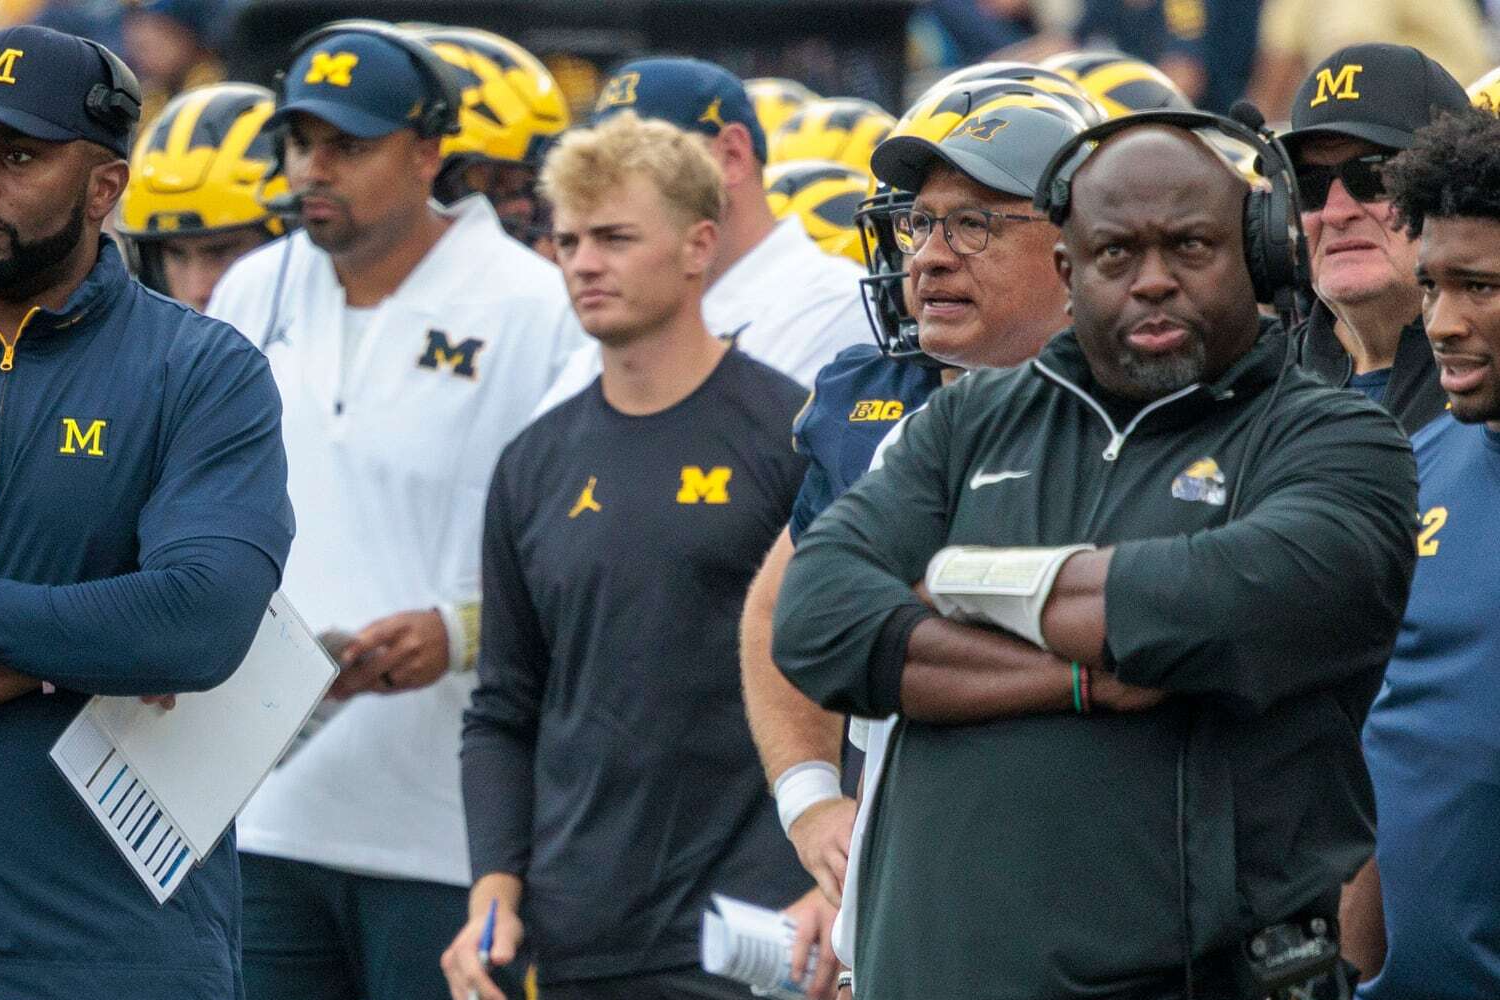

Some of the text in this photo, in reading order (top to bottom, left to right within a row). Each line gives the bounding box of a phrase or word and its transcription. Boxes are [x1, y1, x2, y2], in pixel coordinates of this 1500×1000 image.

[304, 51, 359, 88] M
[1309, 64, 1363, 108] M
[417, 328, 484, 378] M
[60, 418, 106, 456] M
[676, 465, 733, 504] M
[1415, 506, 1448, 557] 2
